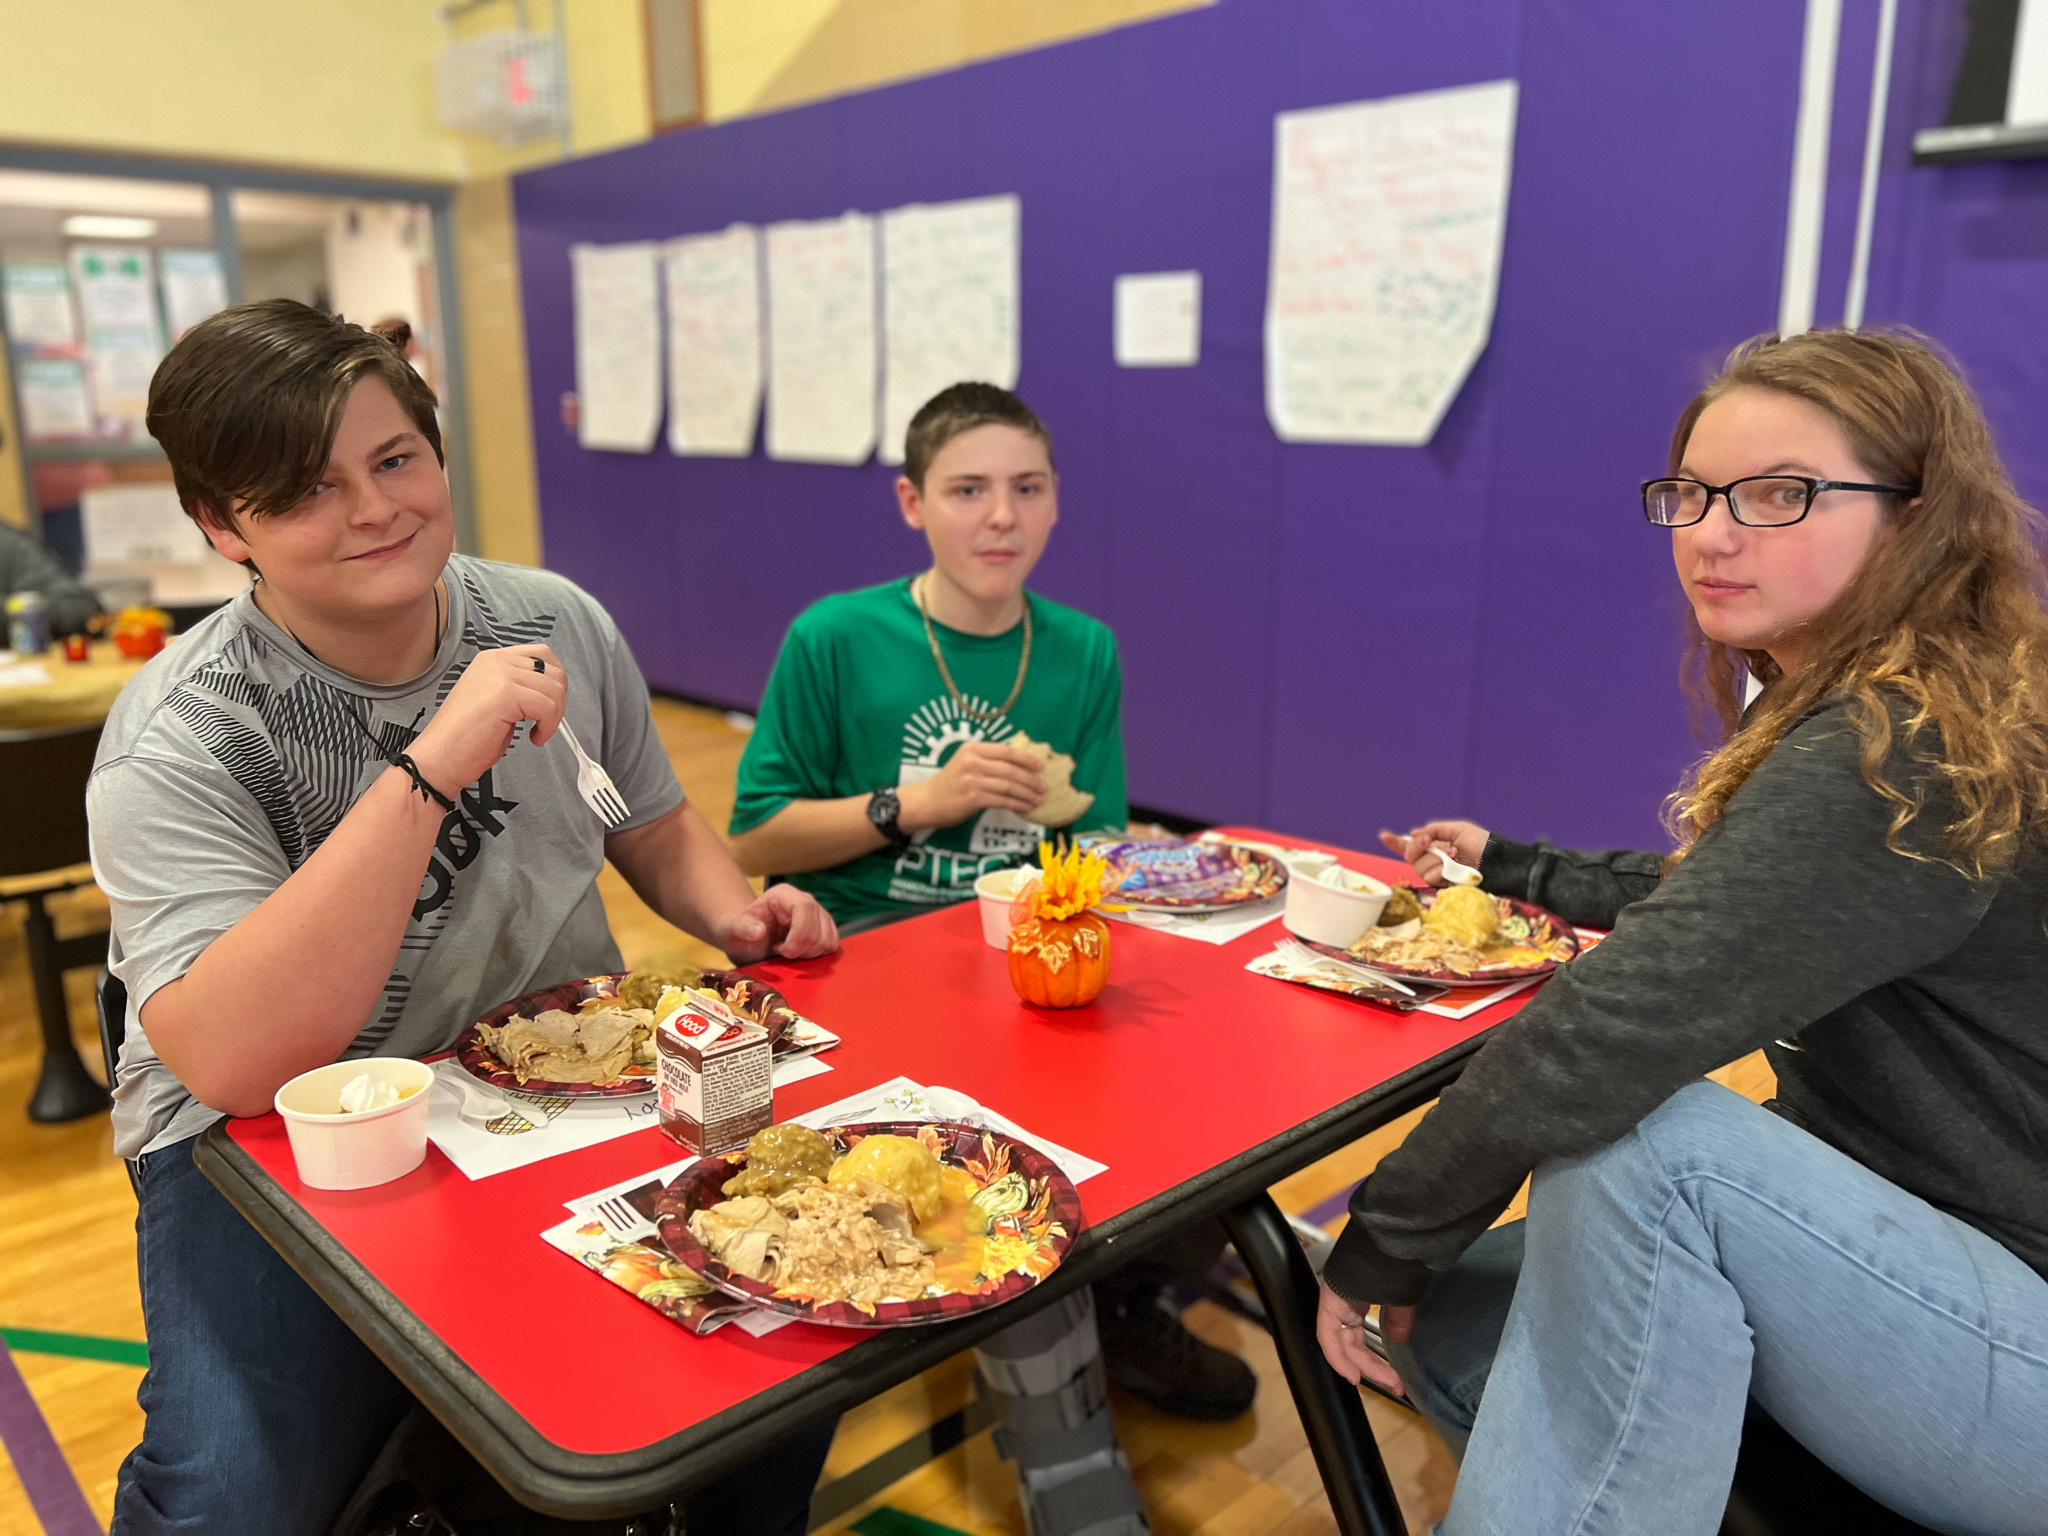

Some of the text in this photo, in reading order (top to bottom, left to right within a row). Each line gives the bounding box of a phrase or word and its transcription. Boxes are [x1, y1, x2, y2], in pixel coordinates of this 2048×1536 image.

[894, 845, 1012, 888] PTEC
[677, 1015, 705, 1035] Hood
[661, 1058, 692, 1086] CHOCOLATE
[703, 1058, 725, 1068] Nutrition
